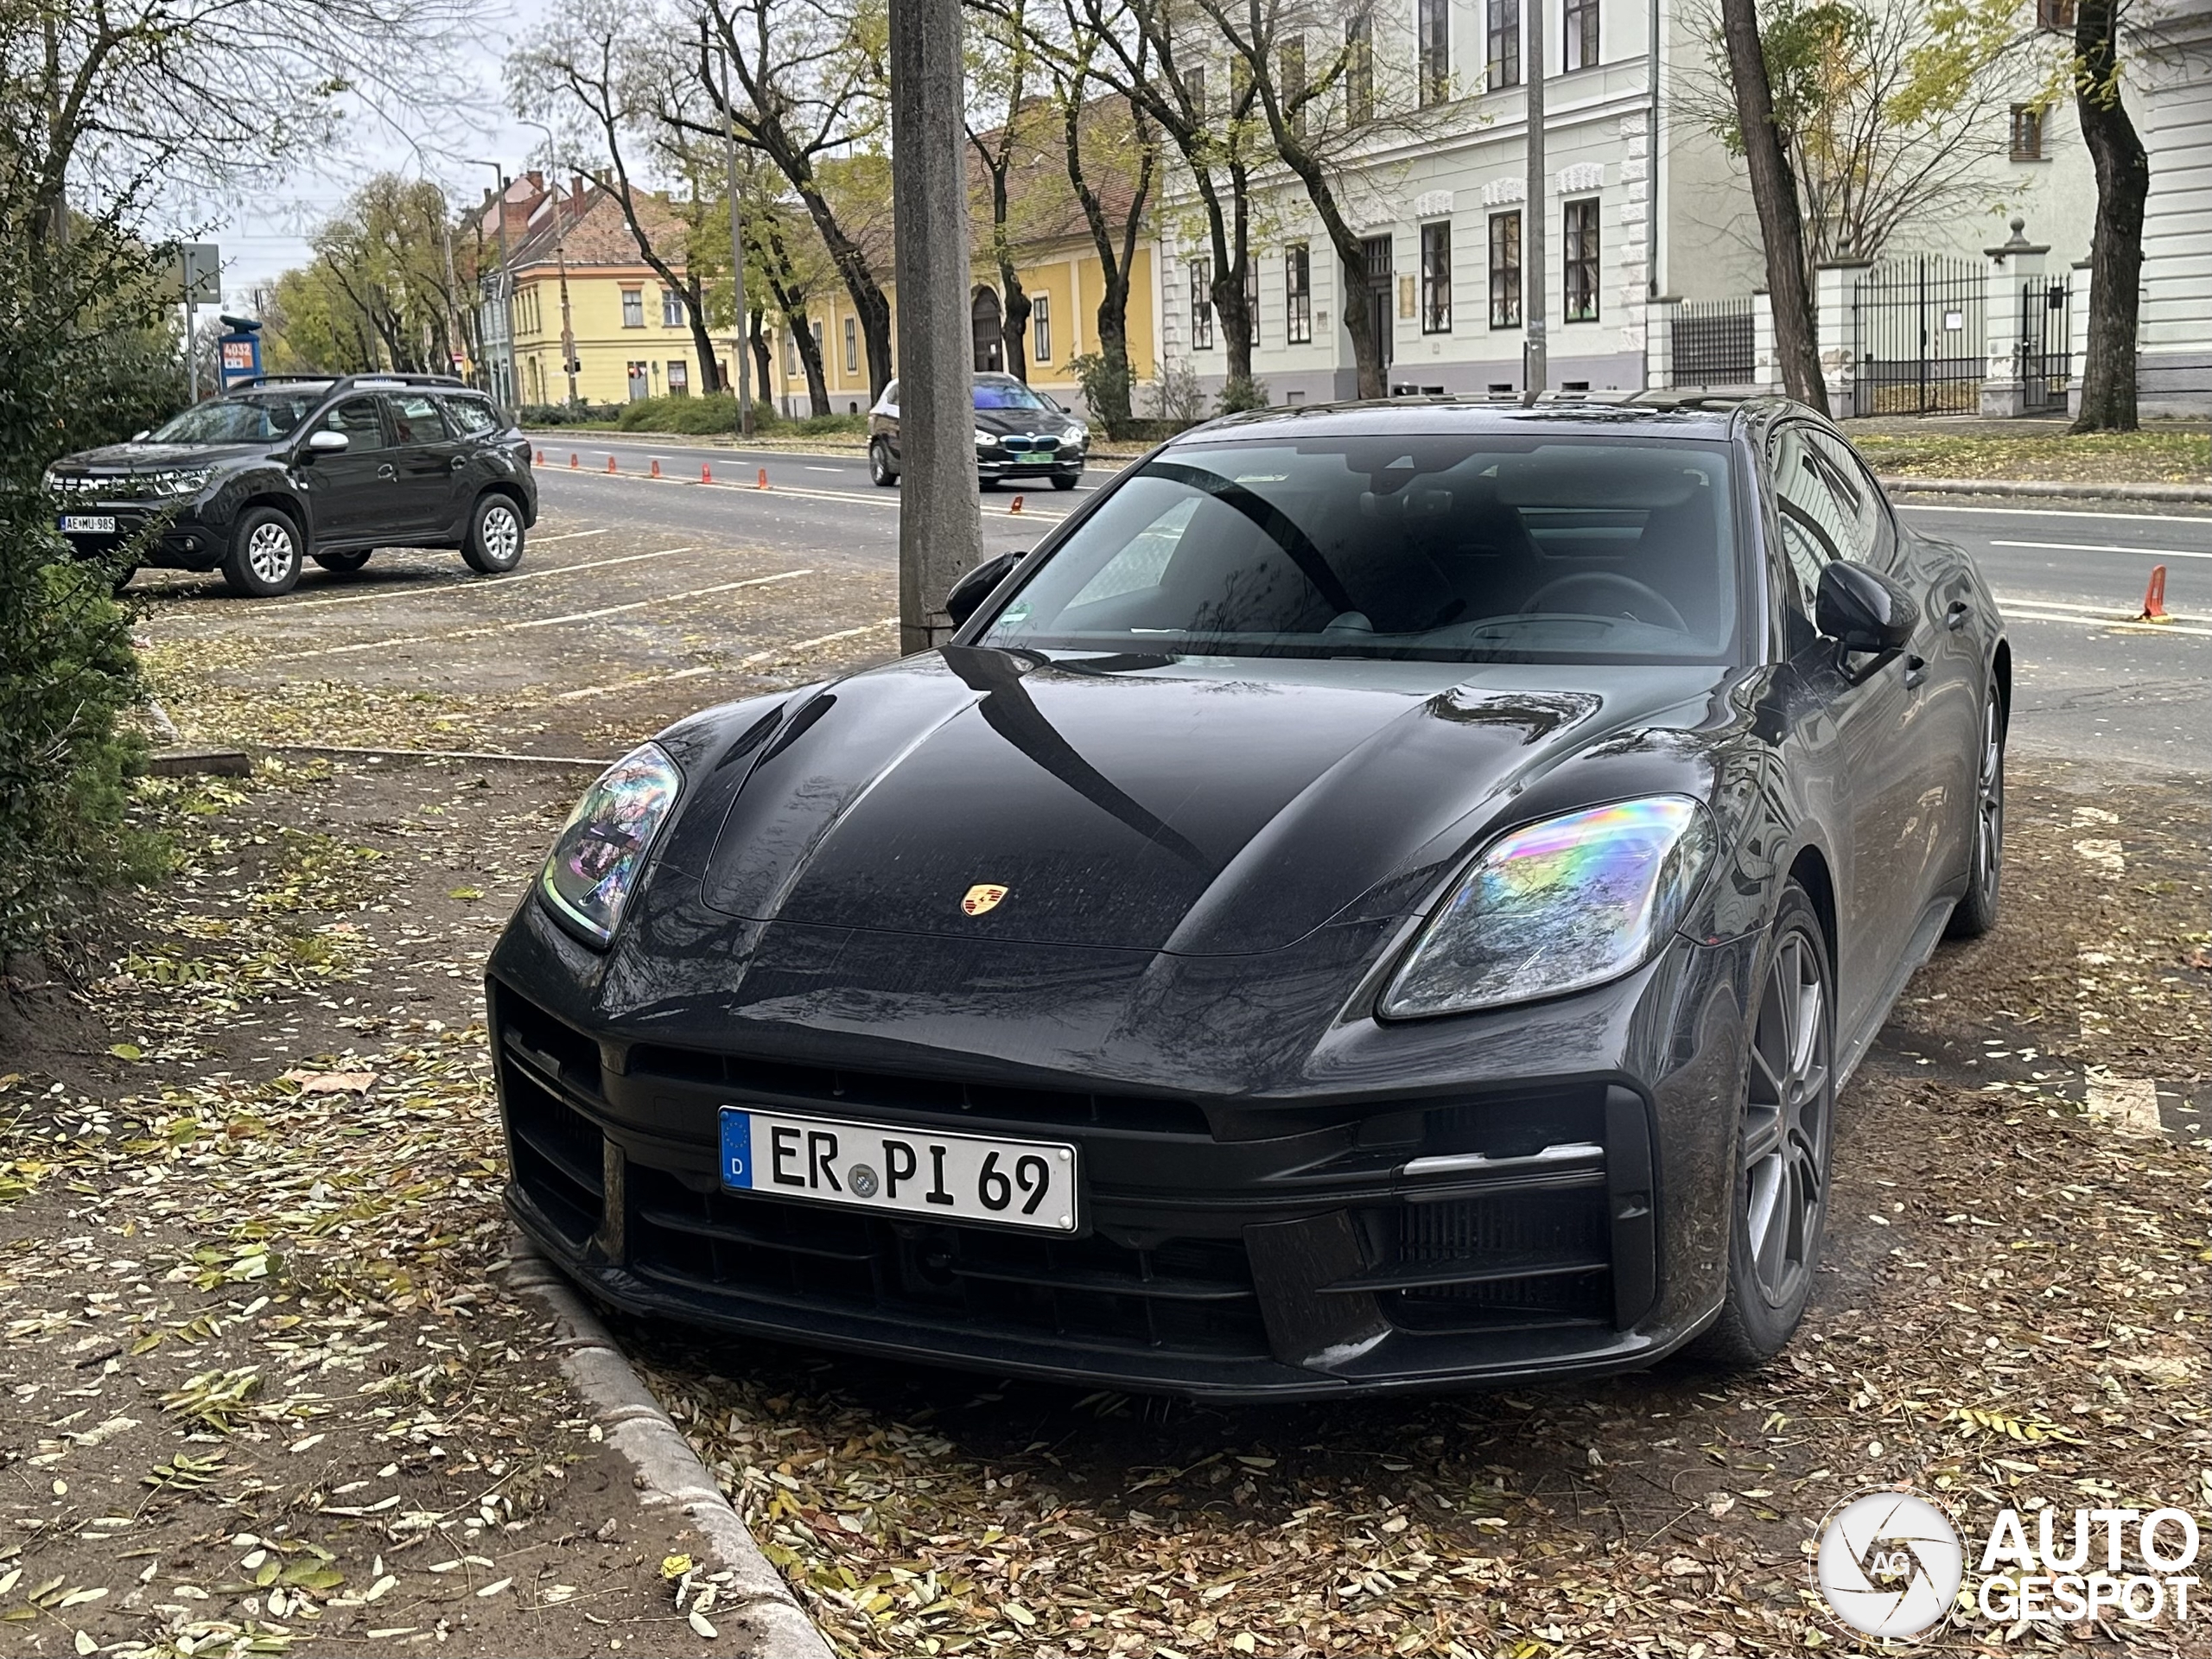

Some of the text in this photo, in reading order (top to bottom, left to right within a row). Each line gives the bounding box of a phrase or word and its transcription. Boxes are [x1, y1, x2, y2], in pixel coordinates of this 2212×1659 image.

[225, 343, 251, 357] 4032
[731, 1158, 743, 1175] D
[771, 1125, 1051, 1216] ER PI 69
